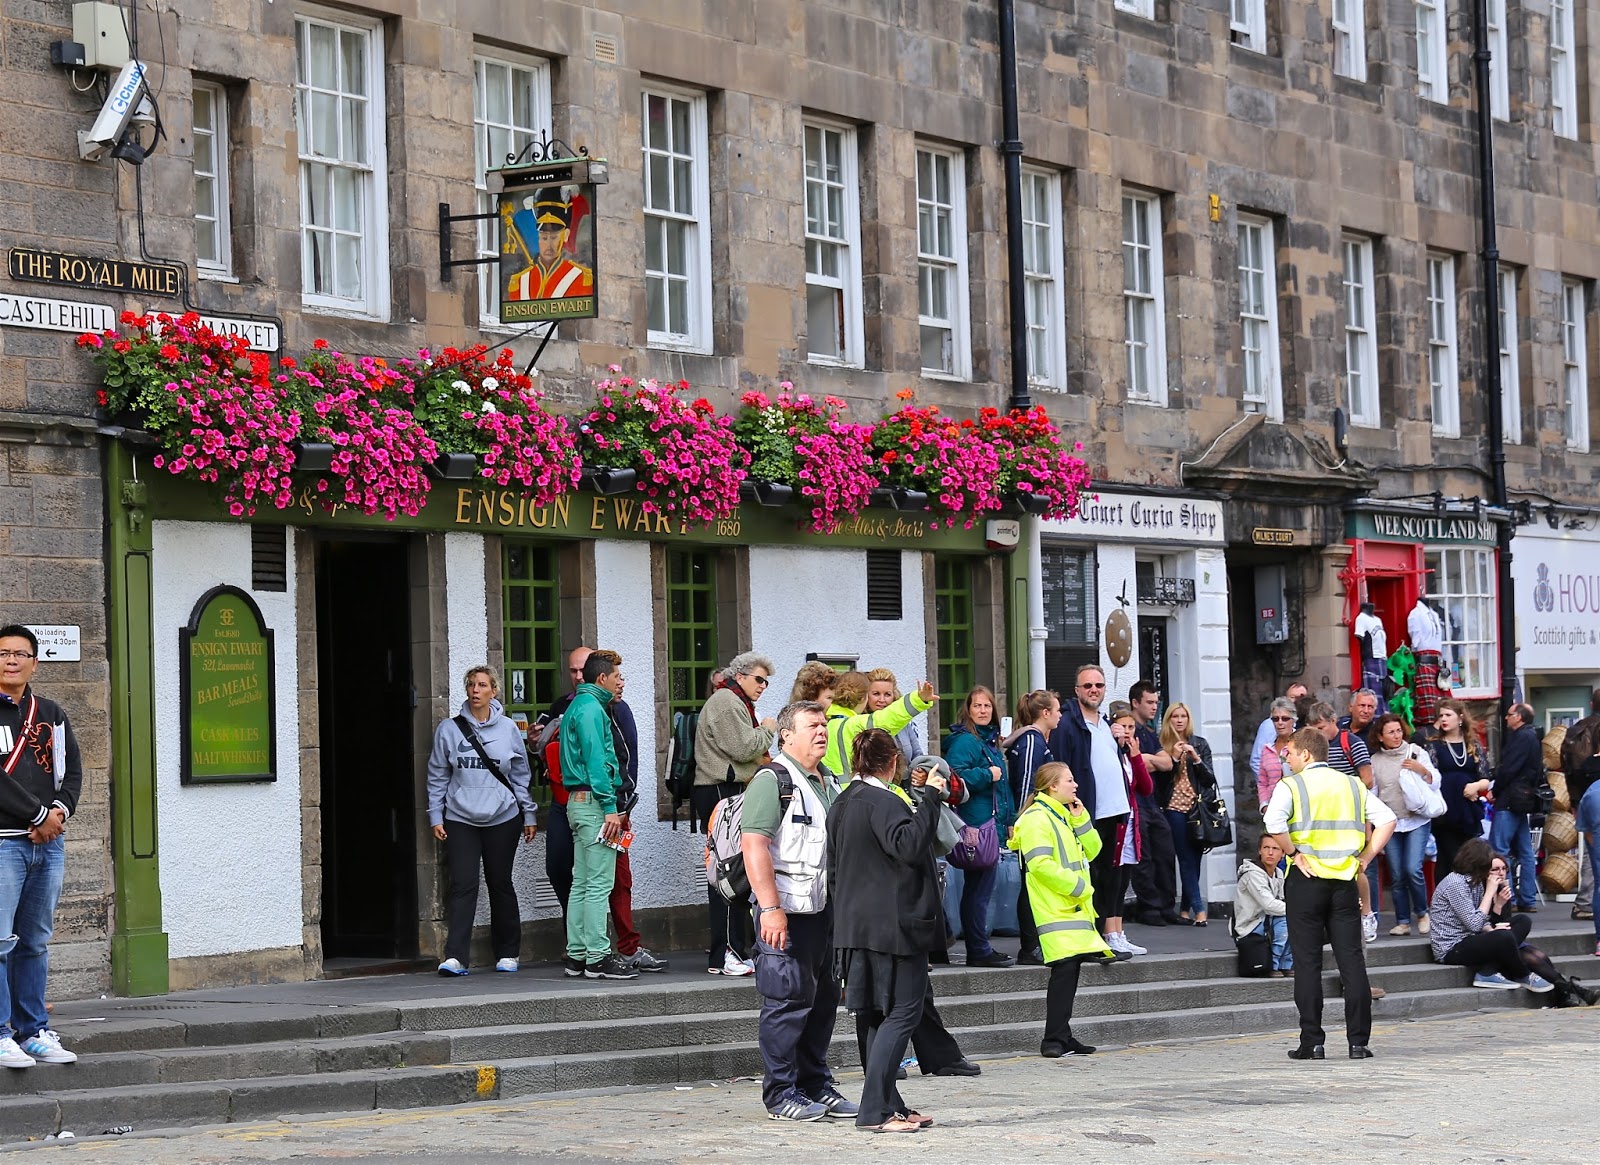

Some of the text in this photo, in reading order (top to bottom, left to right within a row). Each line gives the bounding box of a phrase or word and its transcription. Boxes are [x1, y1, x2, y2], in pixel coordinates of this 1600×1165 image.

[14, 252, 176, 293] THE ROYAL MILE
[0, 298, 111, 331] CASTLEHILL
[505, 300, 591, 317] ENSIGN EWART
[455, 488, 571, 528] ENSIGN
[1181, 503, 1216, 536] Shop
[716, 520, 741, 536] 1680
[876, 519, 888, 541] &
[888, 518, 924, 538] Beers
[1374, 514, 1401, 536] WEE
[1402, 517, 1476, 539] SCOTLAND
[44, 629, 67, 637] loading
[1533, 626, 1586, 651] Scottish gifts
[192, 642, 263, 656] ENSIGN EWART
[197, 674, 258, 705] BAR MEALS
[201, 727, 259, 742] CASK ALES
[193, 750, 267, 765] MALT WHISKIES
